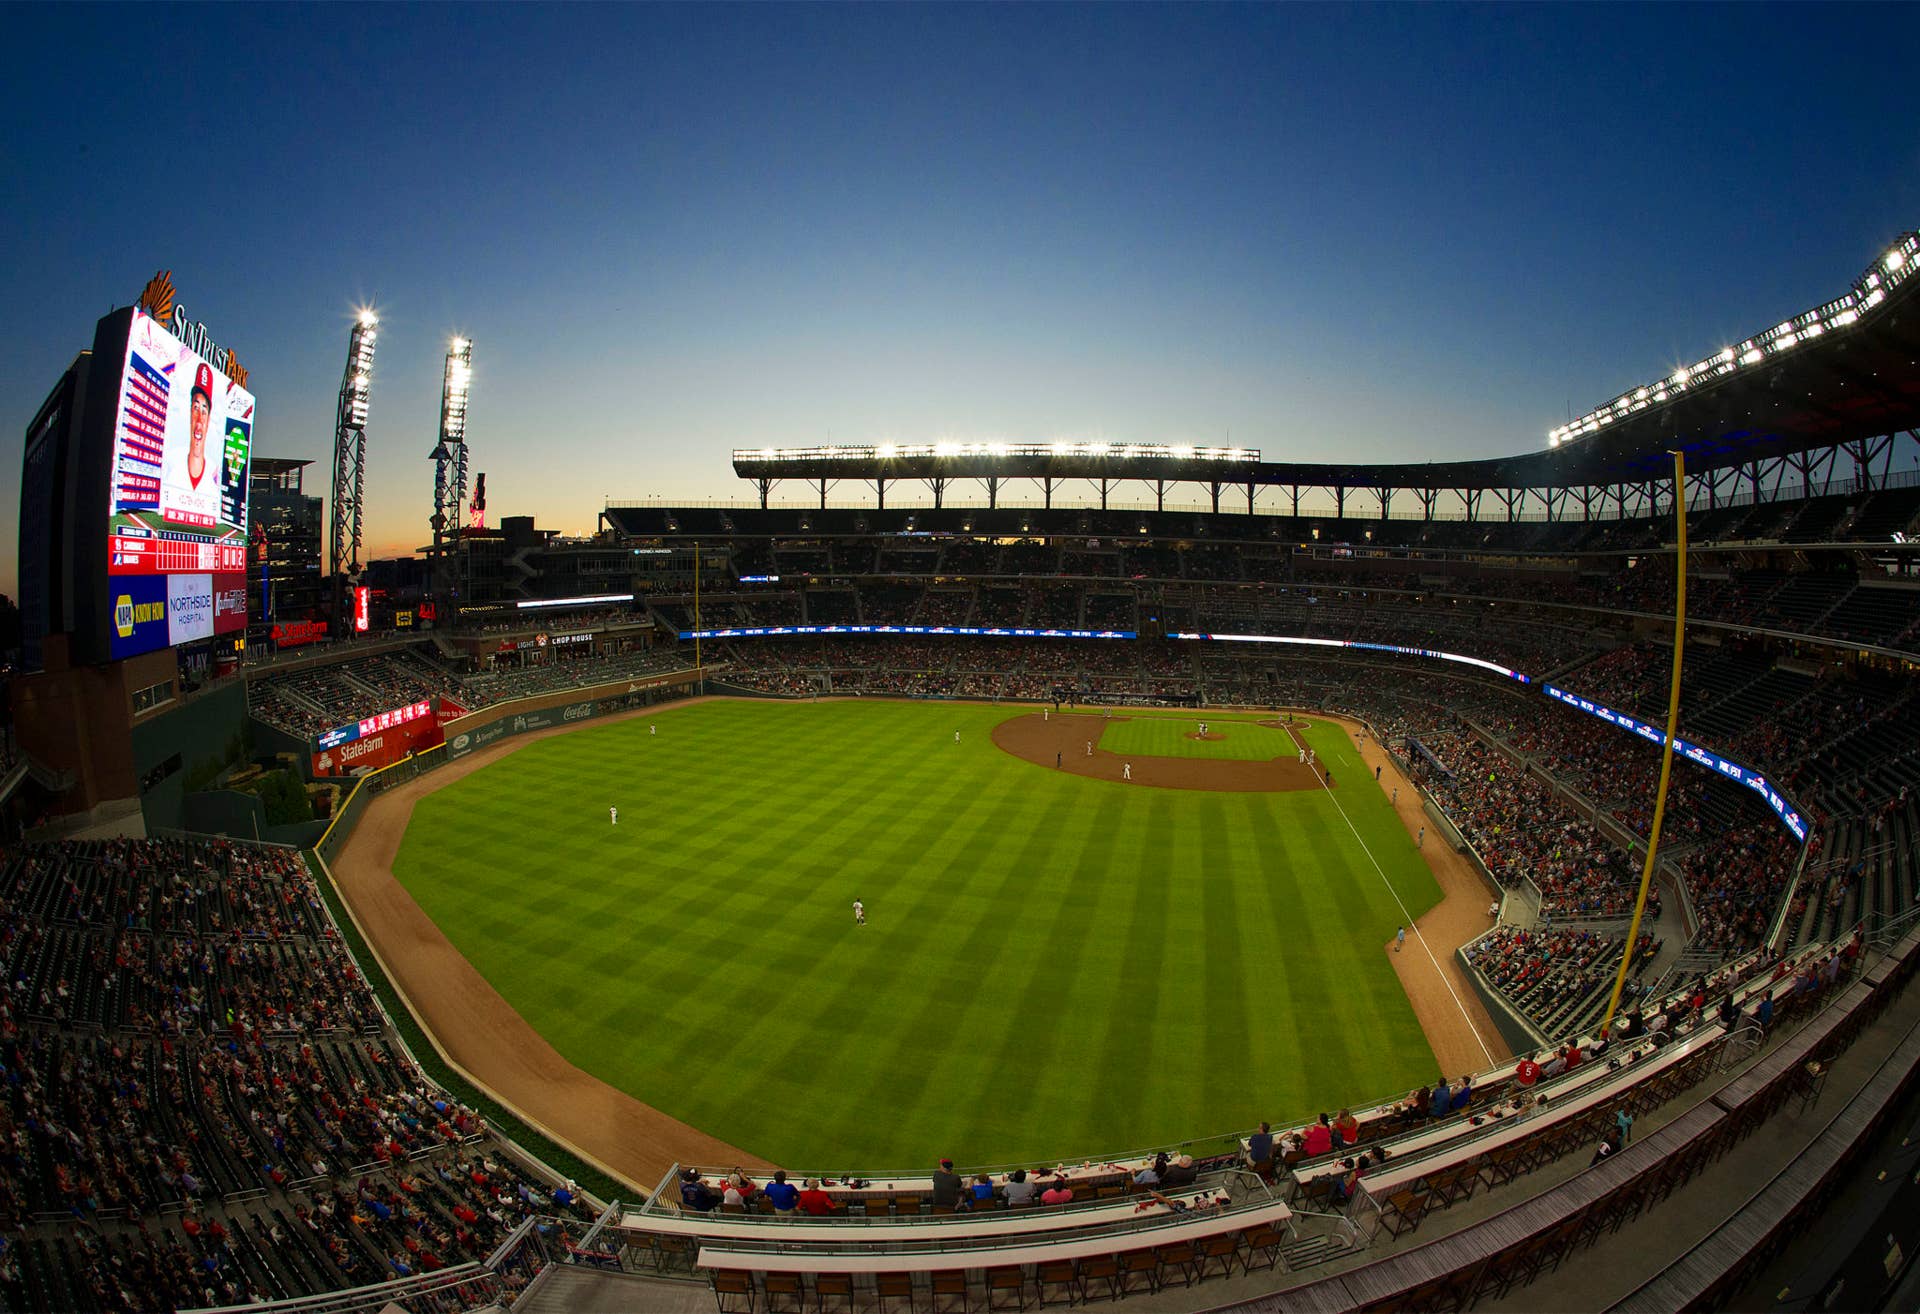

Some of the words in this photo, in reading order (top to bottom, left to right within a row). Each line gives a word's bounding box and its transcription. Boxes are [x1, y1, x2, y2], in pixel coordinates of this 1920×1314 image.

[170, 595, 211, 612] NORTHSIDE
[118, 605, 132, 626] NAPA
[135, 603, 151, 624] KNOW
[152, 602, 164, 621] HOW
[179, 612, 205, 625] HOSPITAL
[517, 641, 535, 649] LIGHT
[552, 636, 569, 645] CHOP
[571, 633, 593, 643] HOUSE
[563, 703, 592, 721] Coca-Cola
[1525, 1067, 1533, 1077] 5
